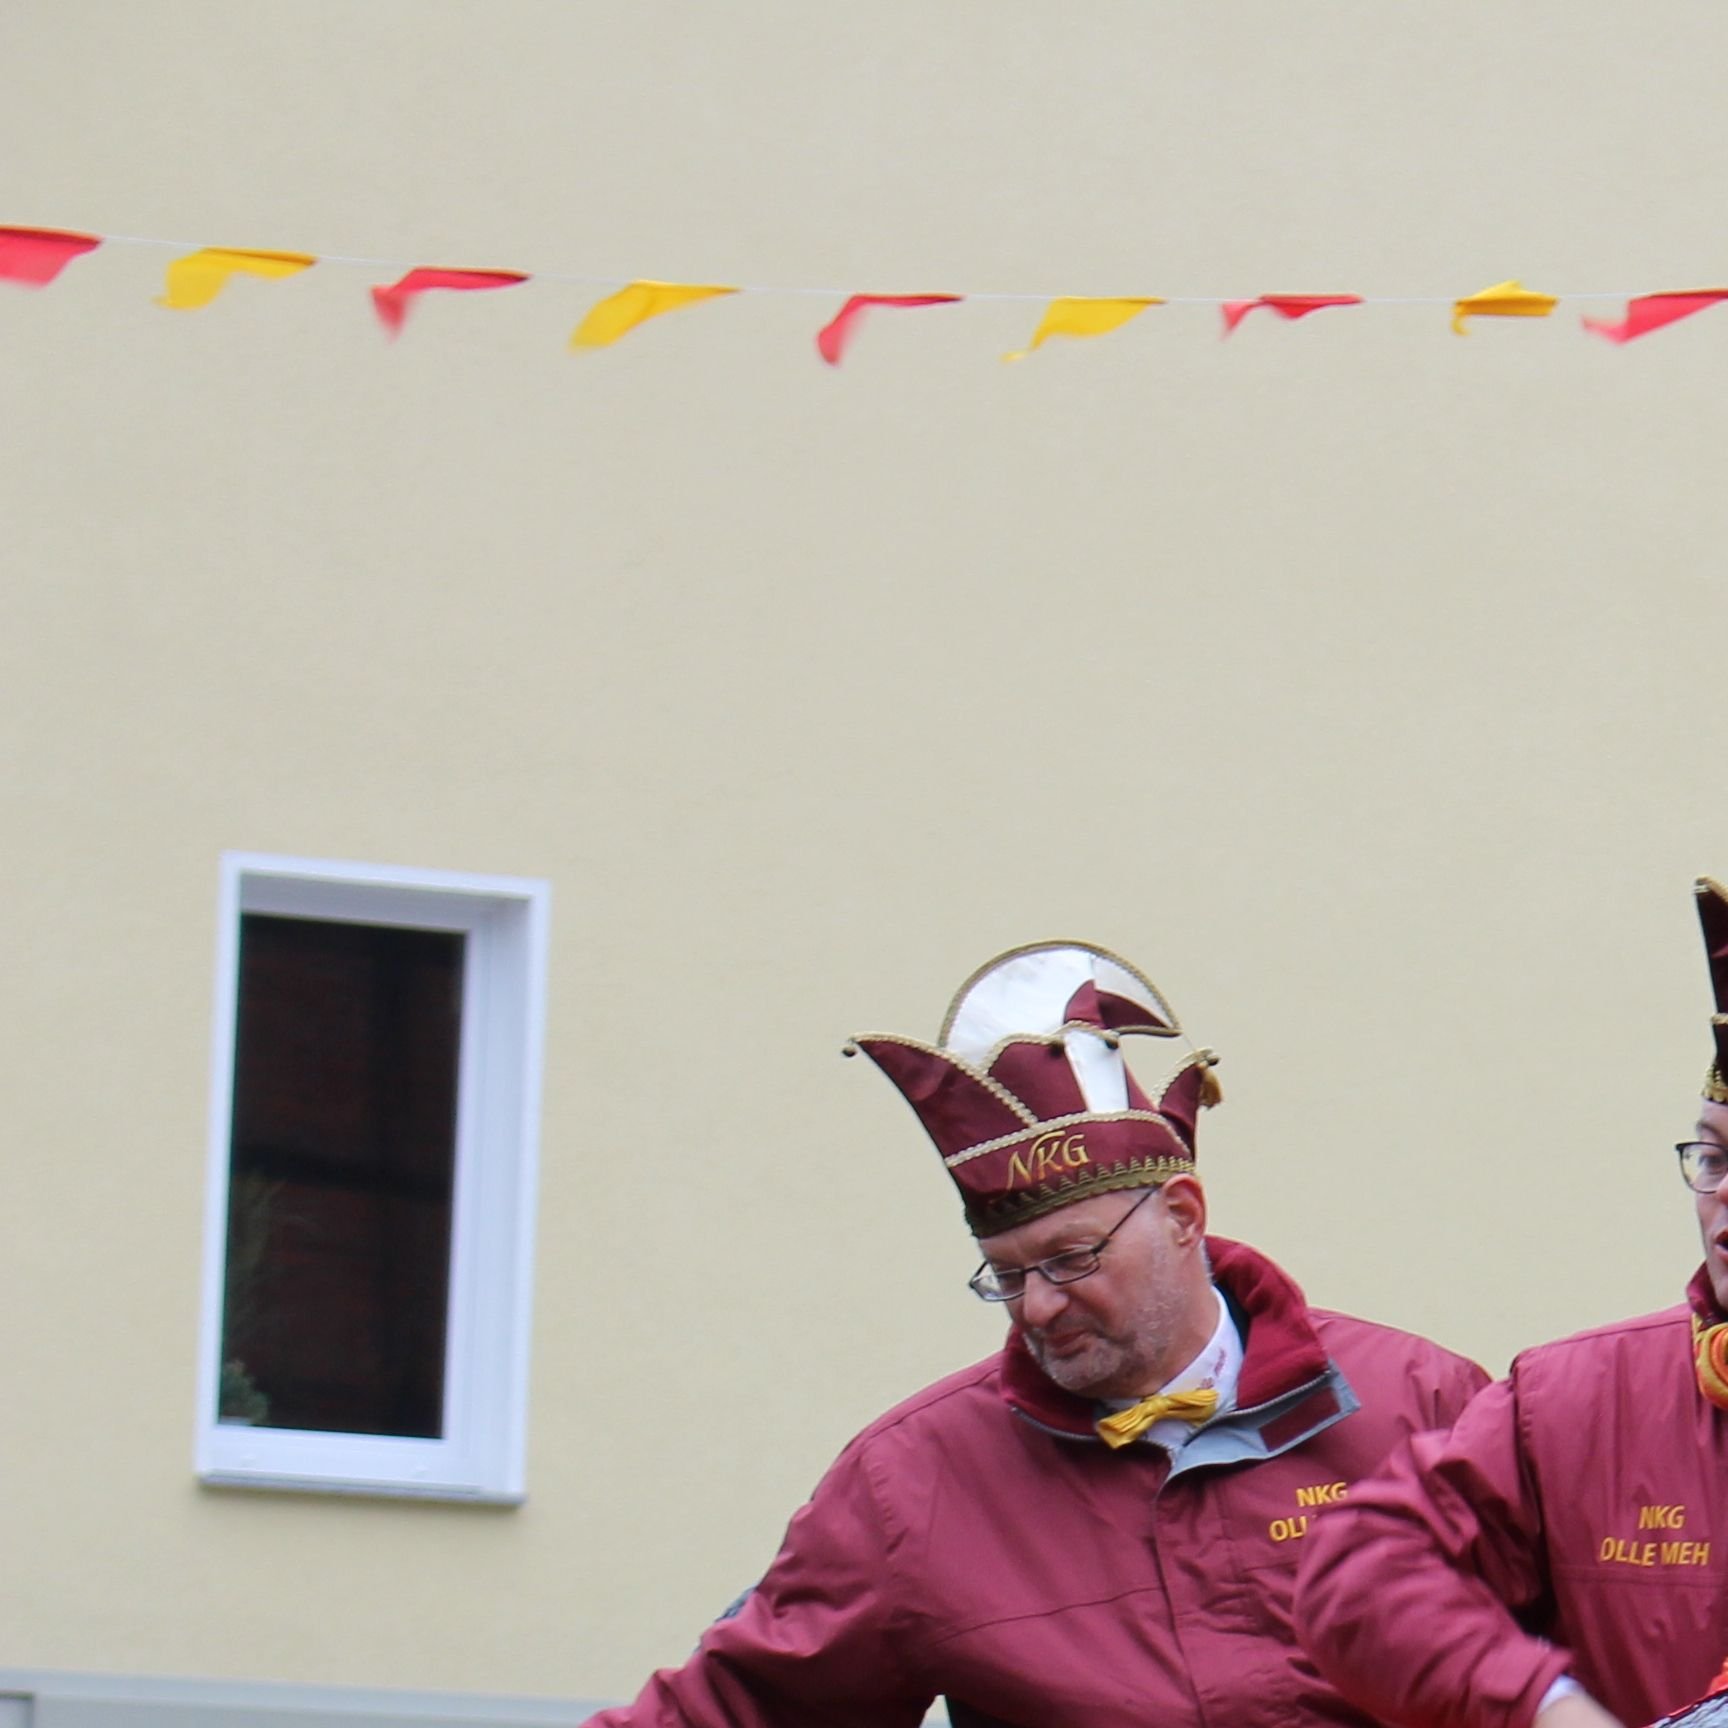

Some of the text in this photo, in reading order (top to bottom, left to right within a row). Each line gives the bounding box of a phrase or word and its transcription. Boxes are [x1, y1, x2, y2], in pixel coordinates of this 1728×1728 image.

[1006, 1130, 1091, 1191] NKG
[1296, 1481, 1348, 1507] NKG
[1638, 1504, 1685, 1530] NKG
[1600, 1536, 1711, 1566] OLLE MEH
